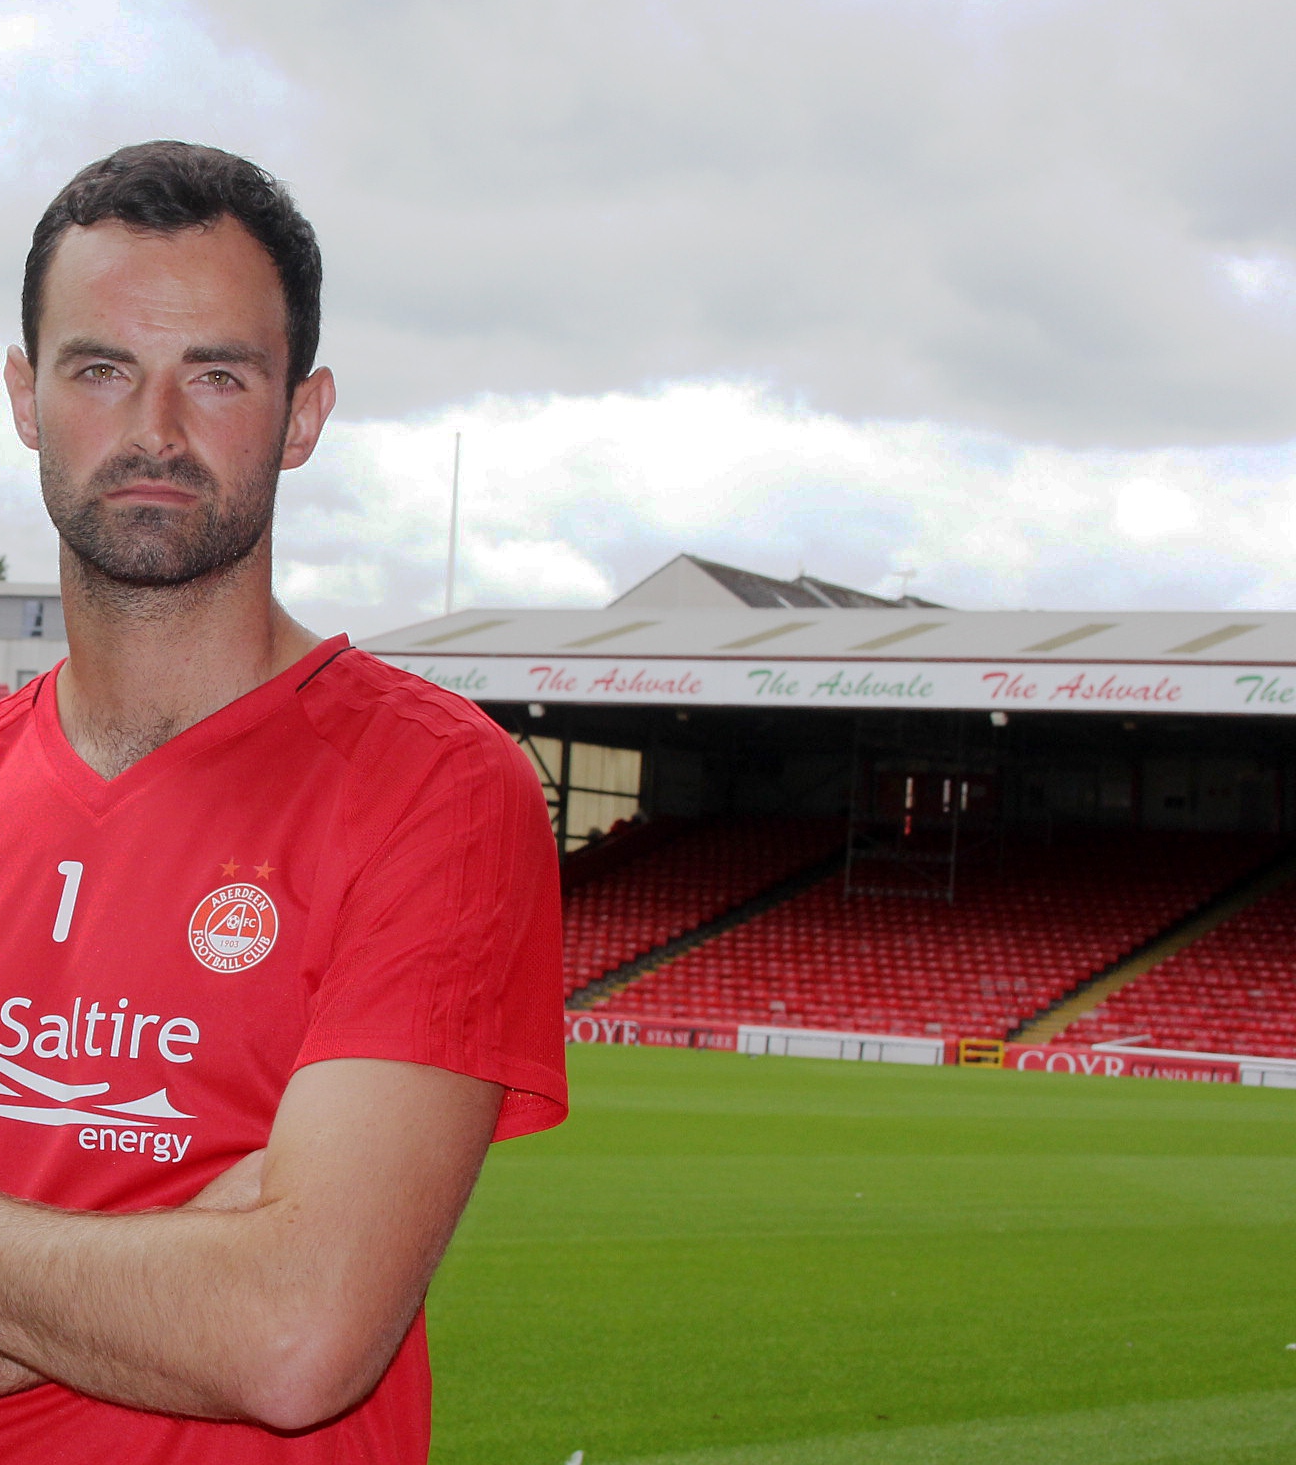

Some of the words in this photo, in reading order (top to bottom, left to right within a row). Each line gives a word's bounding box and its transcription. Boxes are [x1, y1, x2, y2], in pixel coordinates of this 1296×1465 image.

[528, 665, 578, 693] The
[586, 666, 702, 695] Ashvale
[747, 669, 800, 697] The
[809, 670, 934, 699] Ashvale
[982, 672, 1037, 700] The
[1048, 672, 1182, 702] Ashvale
[1234, 675, 1296, 704] The
[52, 860, 84, 943] 1
[211, 887, 270, 912] ABERDEEN
[192, 929, 242, 970] FOOTBALL
[243, 936, 271, 963] CLUB
[220, 939, 240, 949] 1903
[565, 1016, 641, 1047] OYR
[77, 1126, 193, 1164] energy
